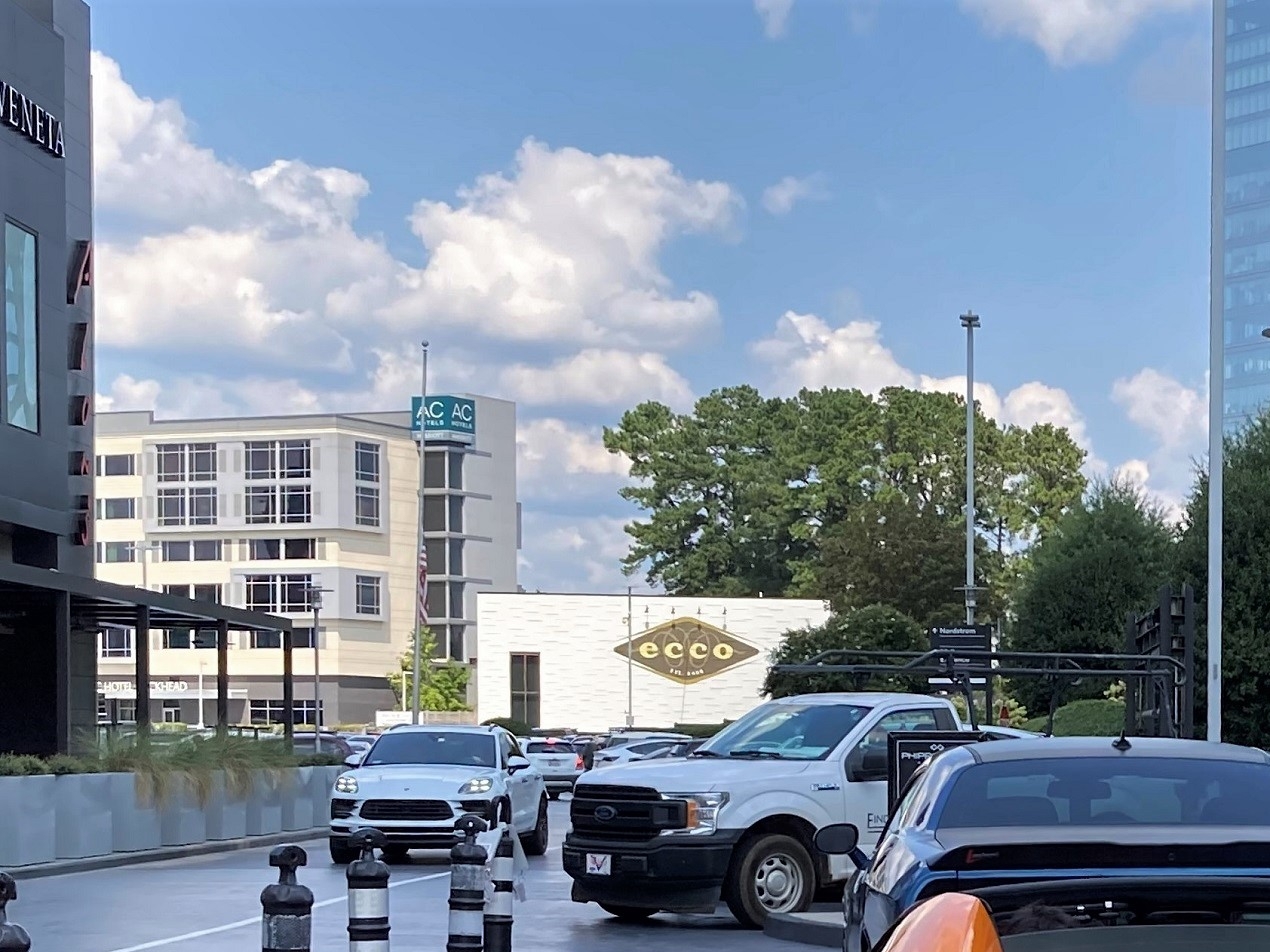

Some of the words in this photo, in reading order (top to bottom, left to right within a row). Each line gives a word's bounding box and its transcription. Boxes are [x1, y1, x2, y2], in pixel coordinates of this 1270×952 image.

[416, 401, 444, 418] AC
[451, 402, 473, 421] AC
[639, 641, 734, 660] ecco
